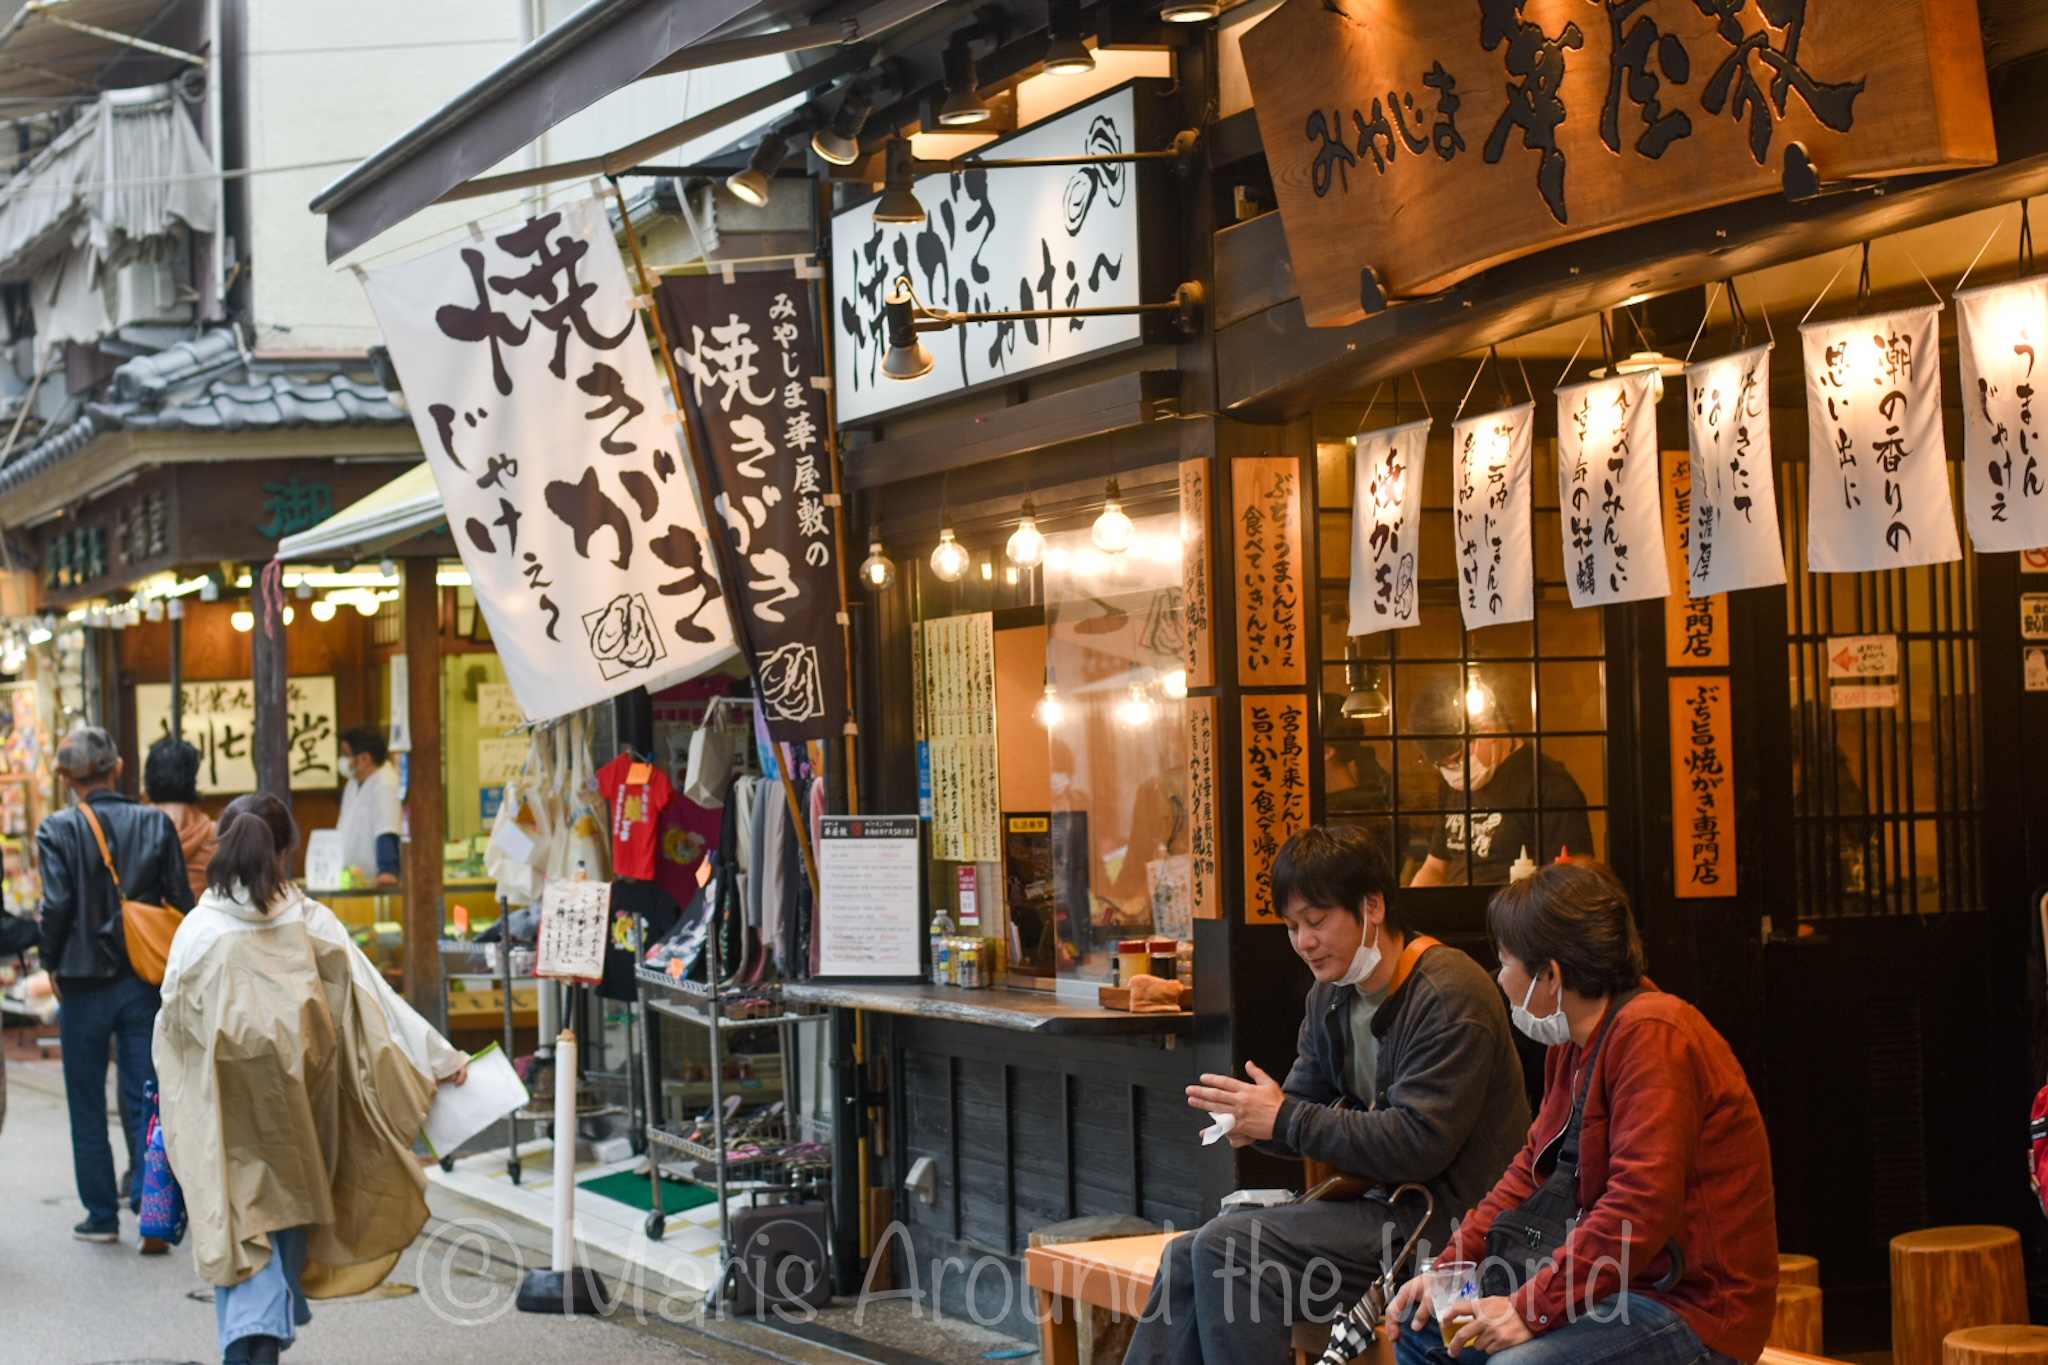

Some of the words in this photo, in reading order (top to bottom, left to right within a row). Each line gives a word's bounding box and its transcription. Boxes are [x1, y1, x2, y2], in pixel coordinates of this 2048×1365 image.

[1307, 61, 1465, 197] みやじま
[436, 213, 723, 644] 焼きがき
[675, 315, 799, 623] 焼きがき
[769, 293, 829, 567] みやじま華屋敷の
[1571, 397, 1596, 596] 宮島の牡蠣
[1602, 389, 1631, 593] 食べてみんさい
[1731, 365, 1763, 523] 焼きたて
[1820, 341, 1861, 510] 思い出に
[1873, 332, 1914, 553] 潮の香りの
[1241, 504, 1270, 672] 食べていきんさい
[1370, 447, 1406, 614] 焼がき
[1190, 709, 1206, 907] ぶち旨みそバター焼がき
[1201, 707, 1215, 876] みやじま華屋敷名物
[1684, 685, 1725, 886] ぶち旨焼がき専門店
